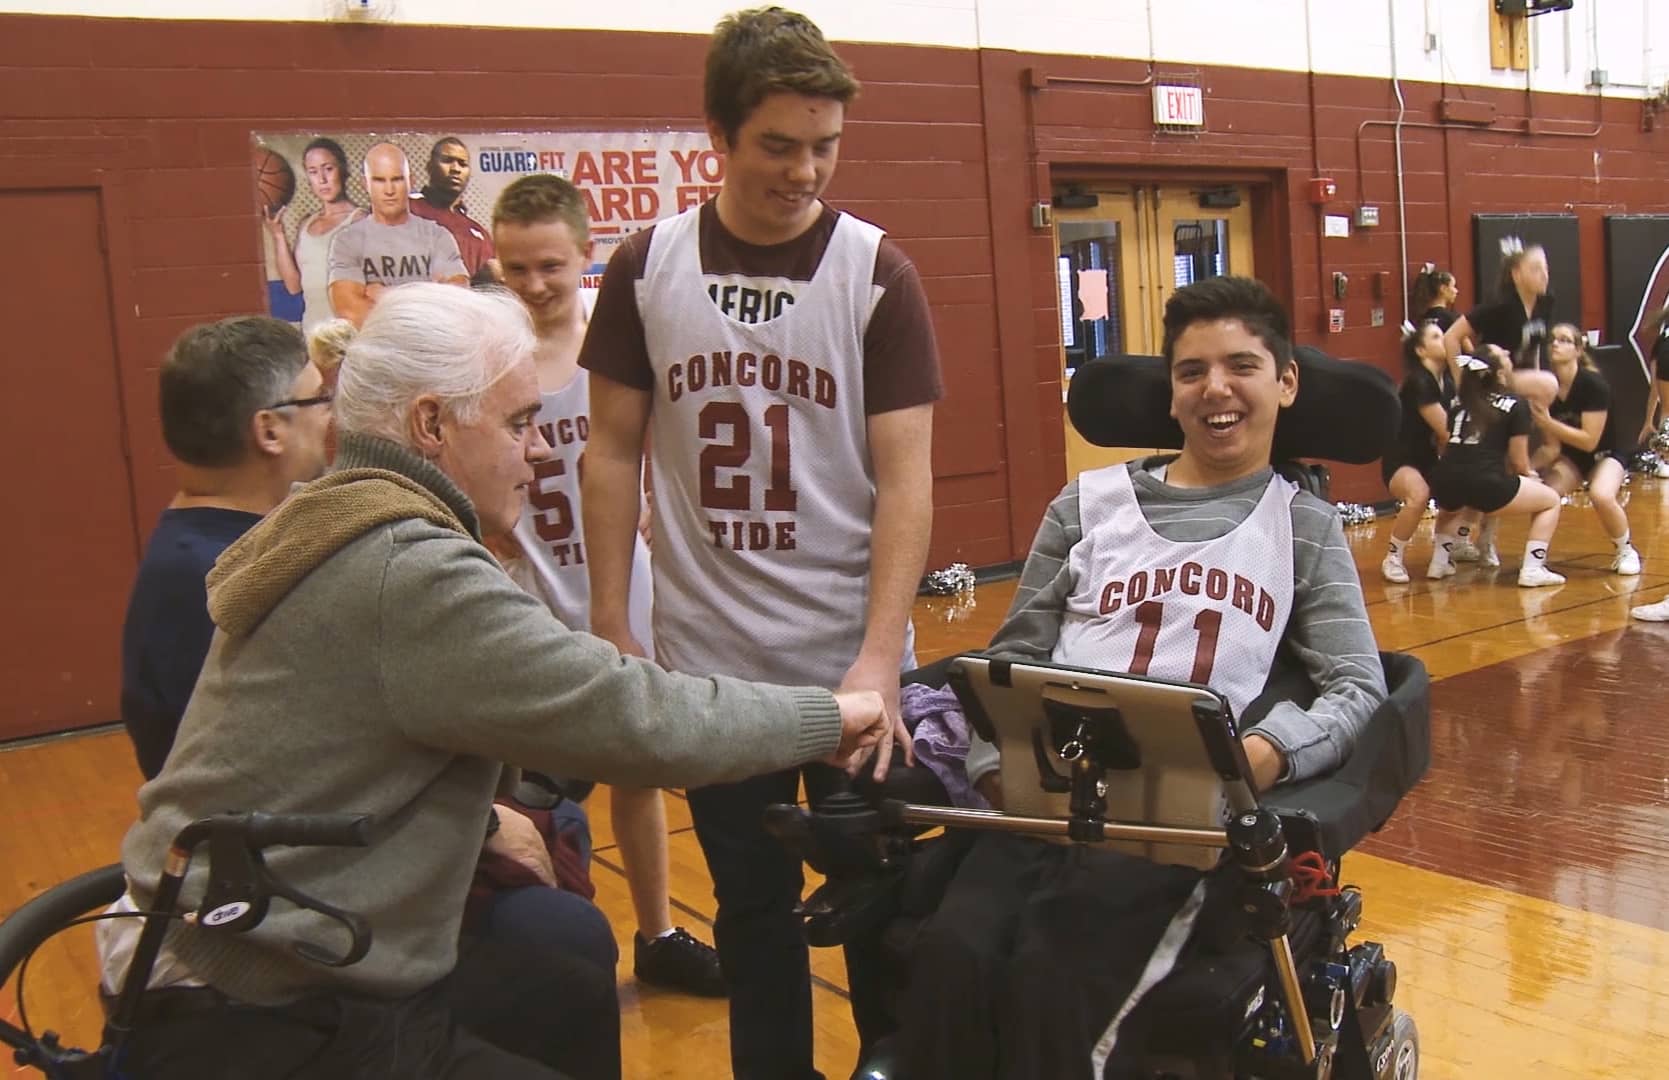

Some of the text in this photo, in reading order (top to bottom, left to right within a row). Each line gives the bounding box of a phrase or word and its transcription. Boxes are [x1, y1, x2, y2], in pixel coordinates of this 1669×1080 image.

[1168, 92, 1194, 119] EXIT
[573, 151, 658, 185] ARE
[362, 255, 432, 278] ARMY
[668, 352, 837, 409] CONCORD
[699, 402, 797, 511] 21
[708, 521, 796, 550] TIDE
[1100, 562, 1275, 632] CONCORD
[1128, 601, 1222, 686] 11
